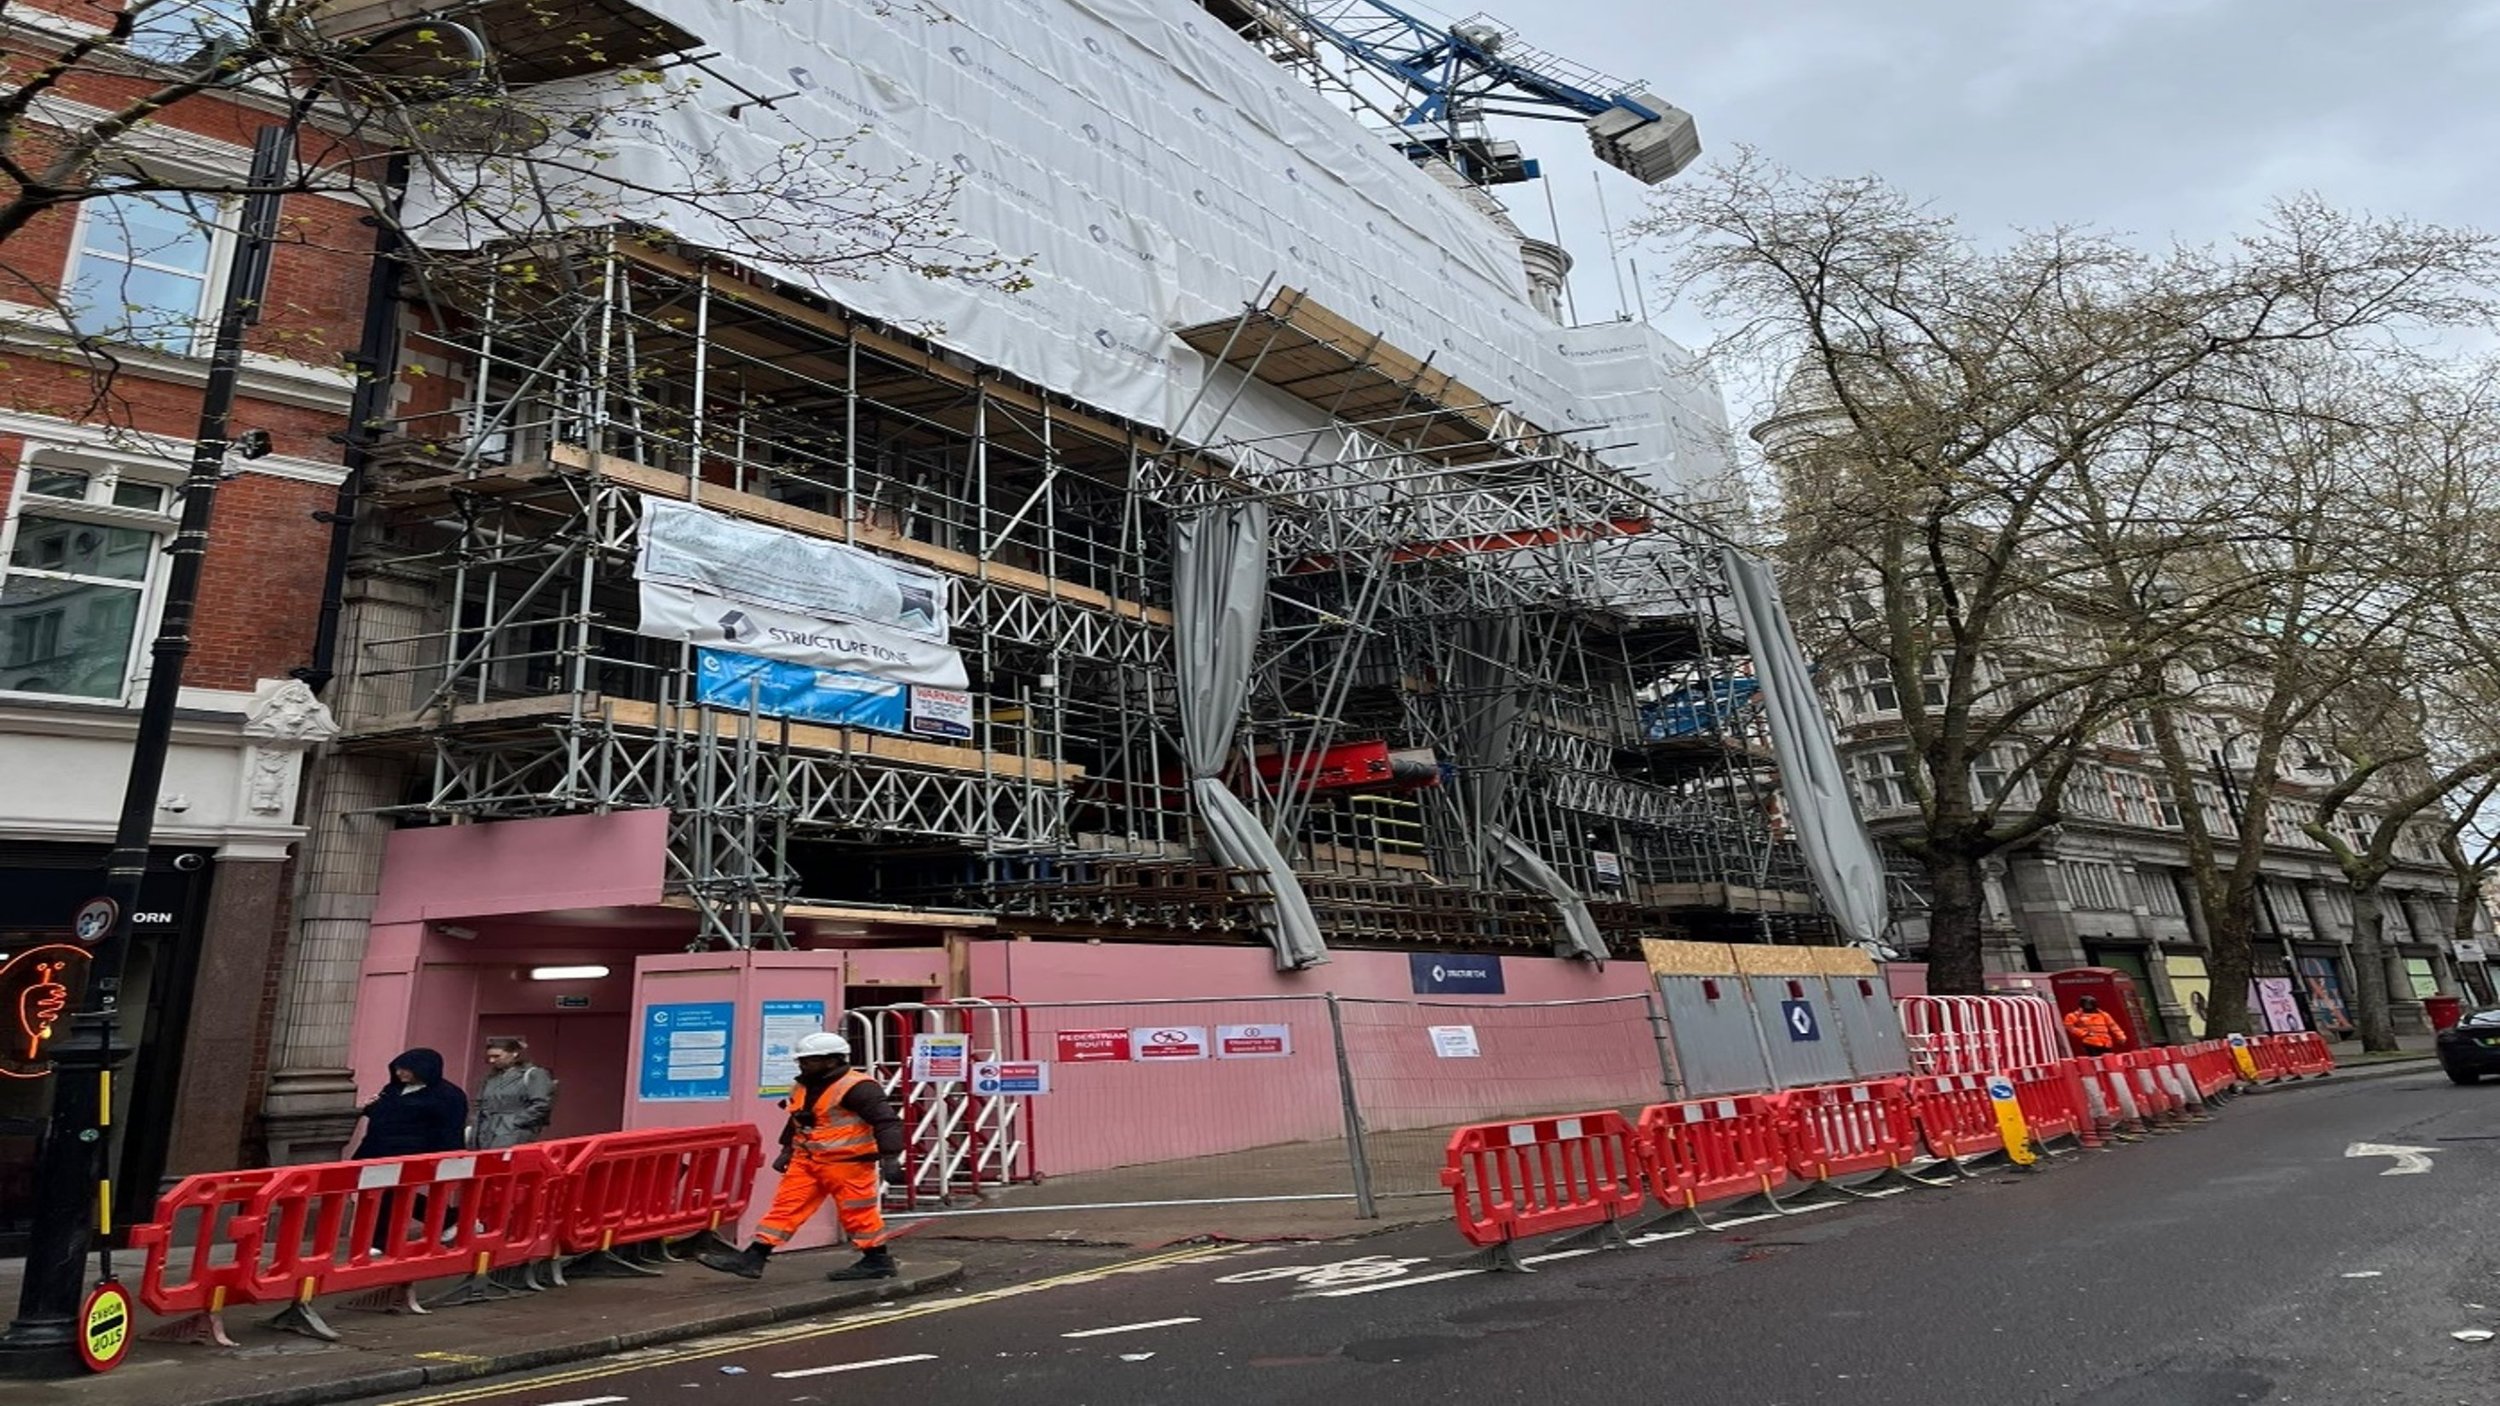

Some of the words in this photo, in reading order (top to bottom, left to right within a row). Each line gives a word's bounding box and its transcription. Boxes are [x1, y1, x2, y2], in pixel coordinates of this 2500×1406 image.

[769, 627, 868, 655] STRUCTURE
[871, 645, 913, 666] TONE
[916, 687, 968, 704] WARNING
[1059, 1032, 1128, 1041] PEDESTRIAN
[90, 1301, 122, 1322] WORKS
[92, 1328, 122, 1353] STOP
